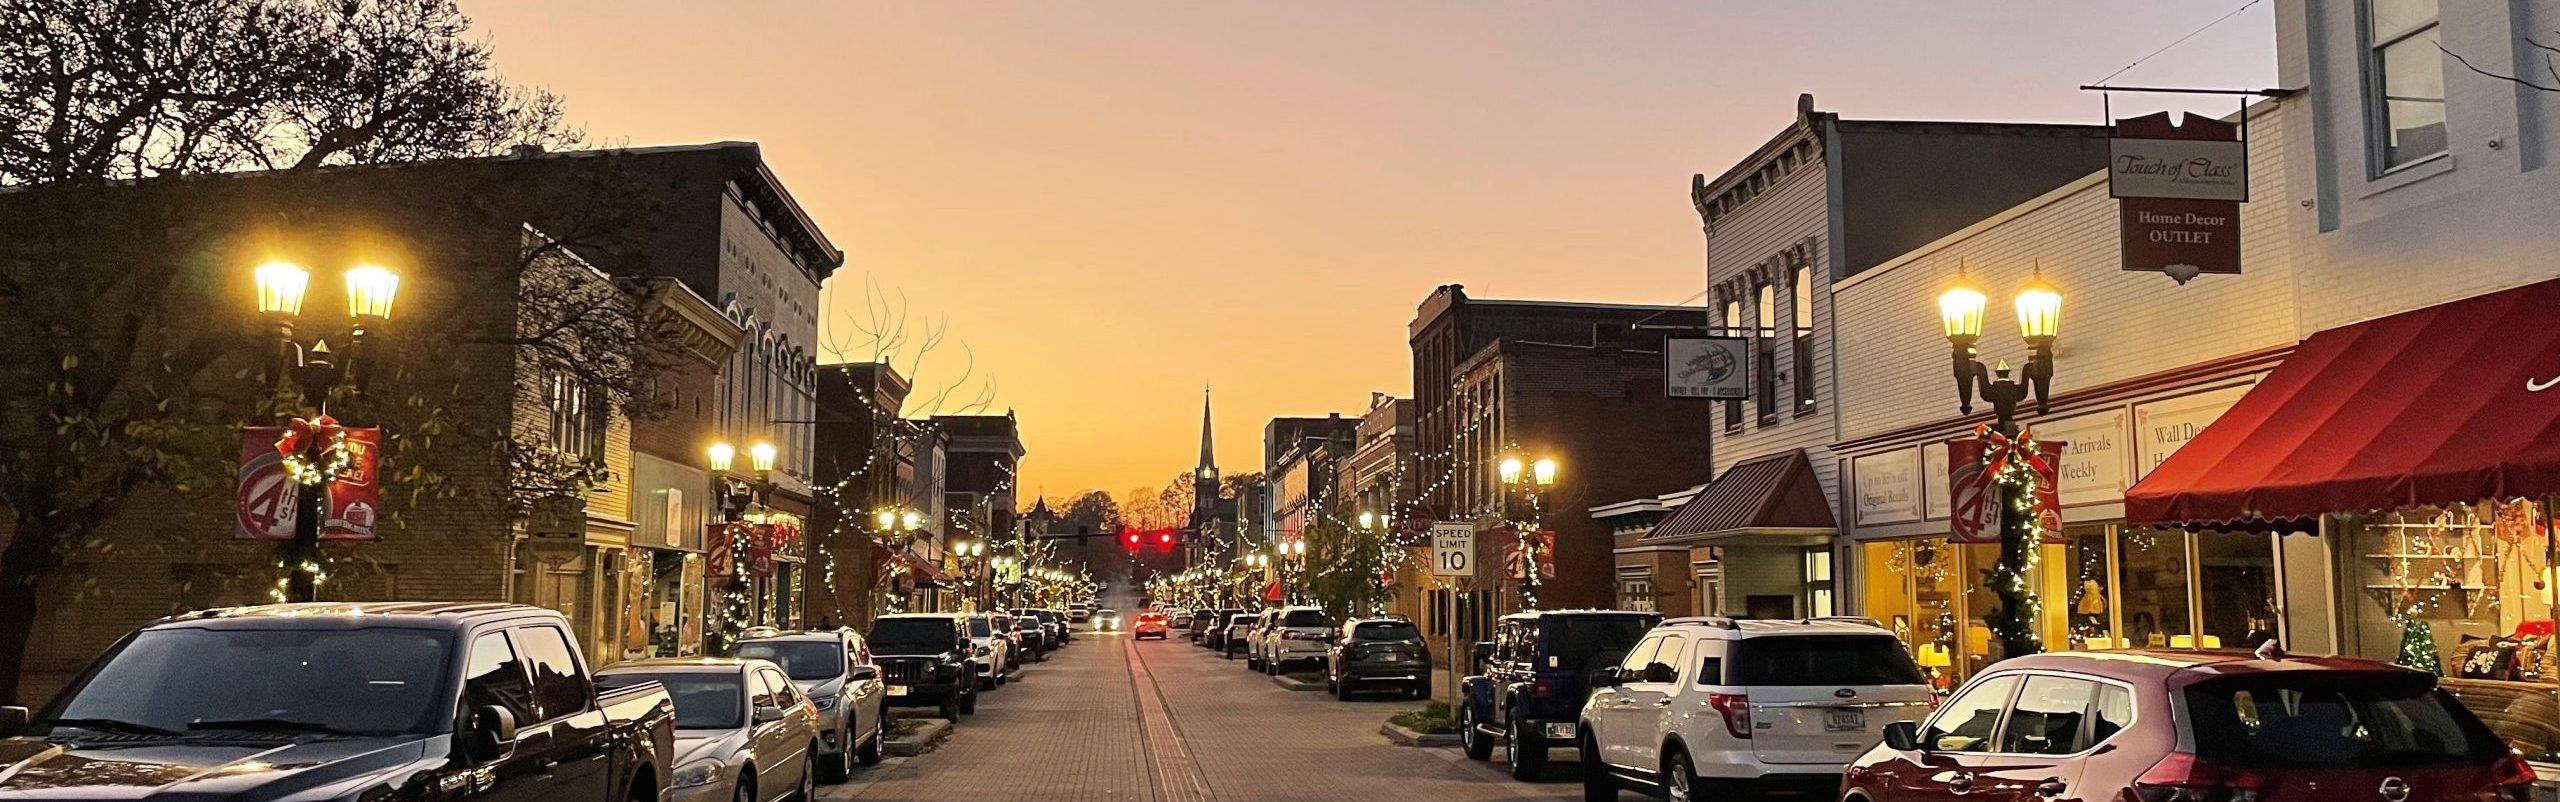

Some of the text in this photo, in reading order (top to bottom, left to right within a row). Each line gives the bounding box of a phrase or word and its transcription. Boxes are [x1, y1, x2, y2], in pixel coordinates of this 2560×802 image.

[2117, 154, 2233, 182] Touch of Class
[2138, 211, 2226, 226] Home Decor
[2149, 230, 2213, 244] OUTLET
[2154, 424, 2180, 444] Wall
[2071, 435, 2112, 456] Arrivals
[2060, 461, 2098, 482] Weekly
[1436, 529, 1471, 538] SPEED
[1439, 540, 1467, 549] LIMIT
[1440, 551, 1466, 571] 10
